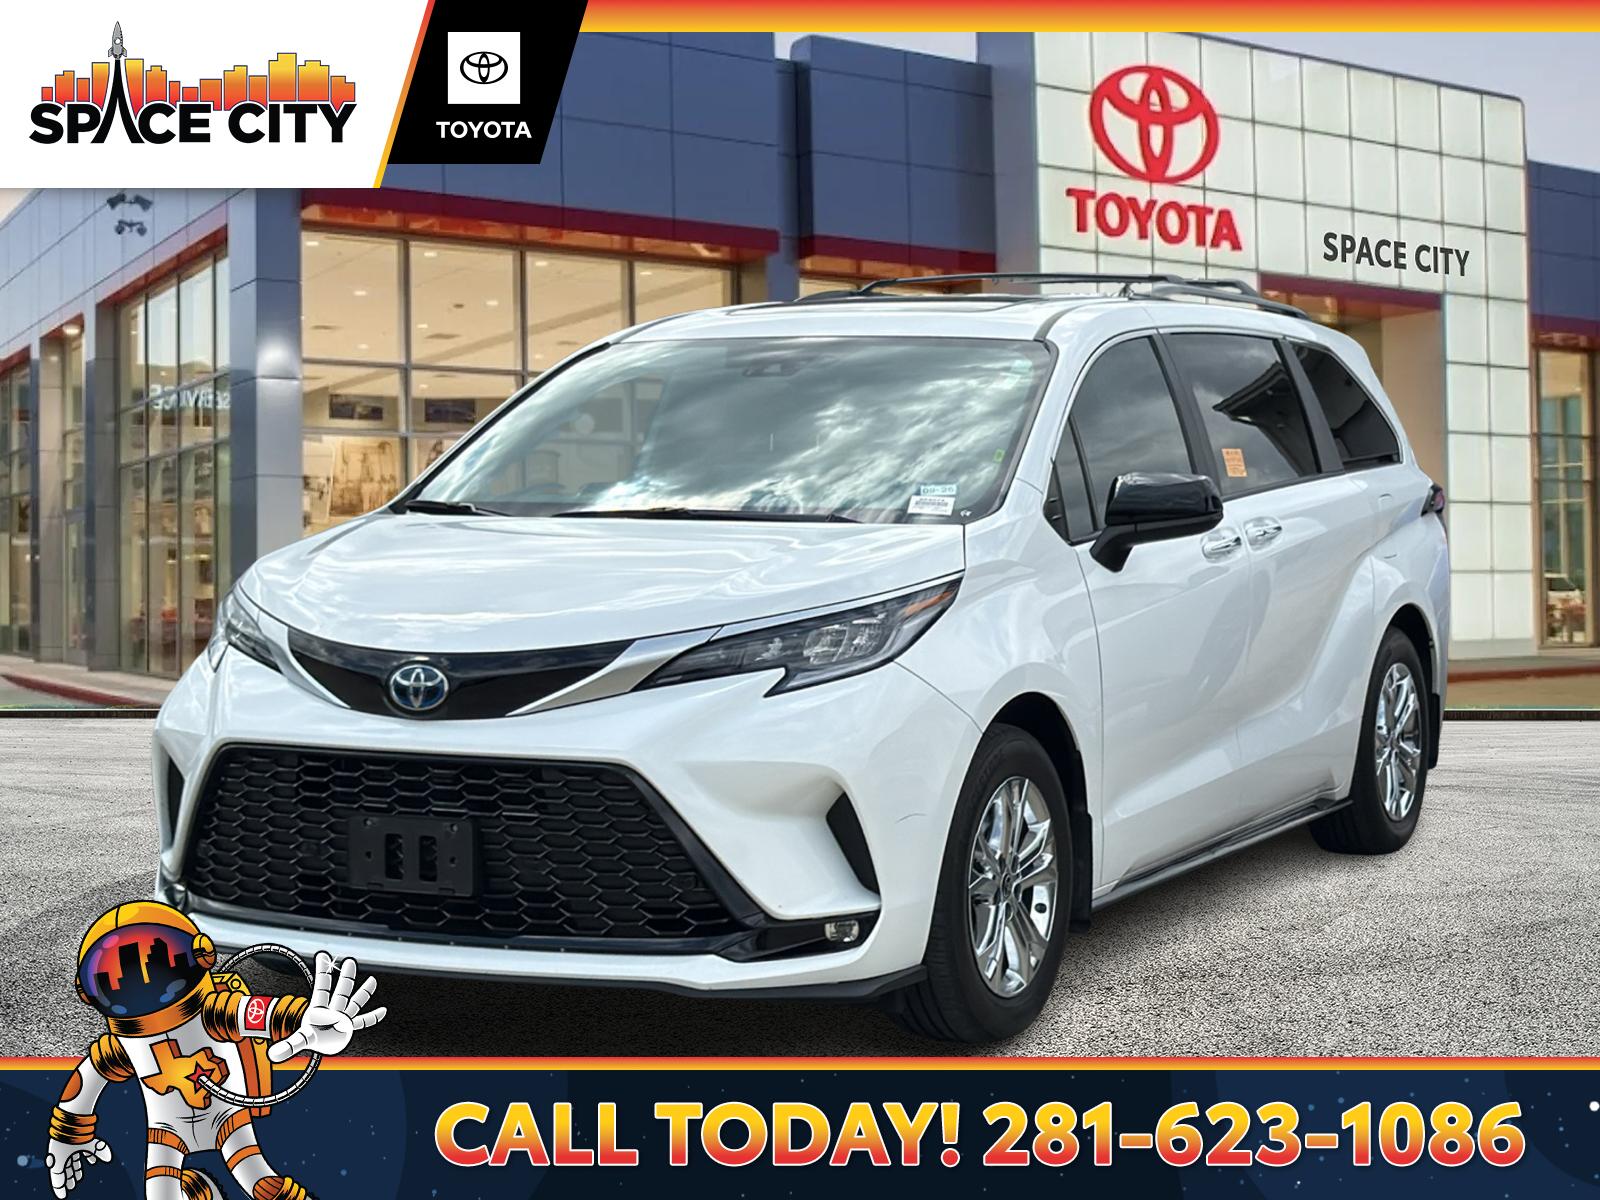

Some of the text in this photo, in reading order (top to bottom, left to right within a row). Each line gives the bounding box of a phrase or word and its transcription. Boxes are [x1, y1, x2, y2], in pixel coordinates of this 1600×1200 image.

[1066, 187, 1243, 252] TOYOTA
[1323, 232, 1471, 277] SPACE CITY
